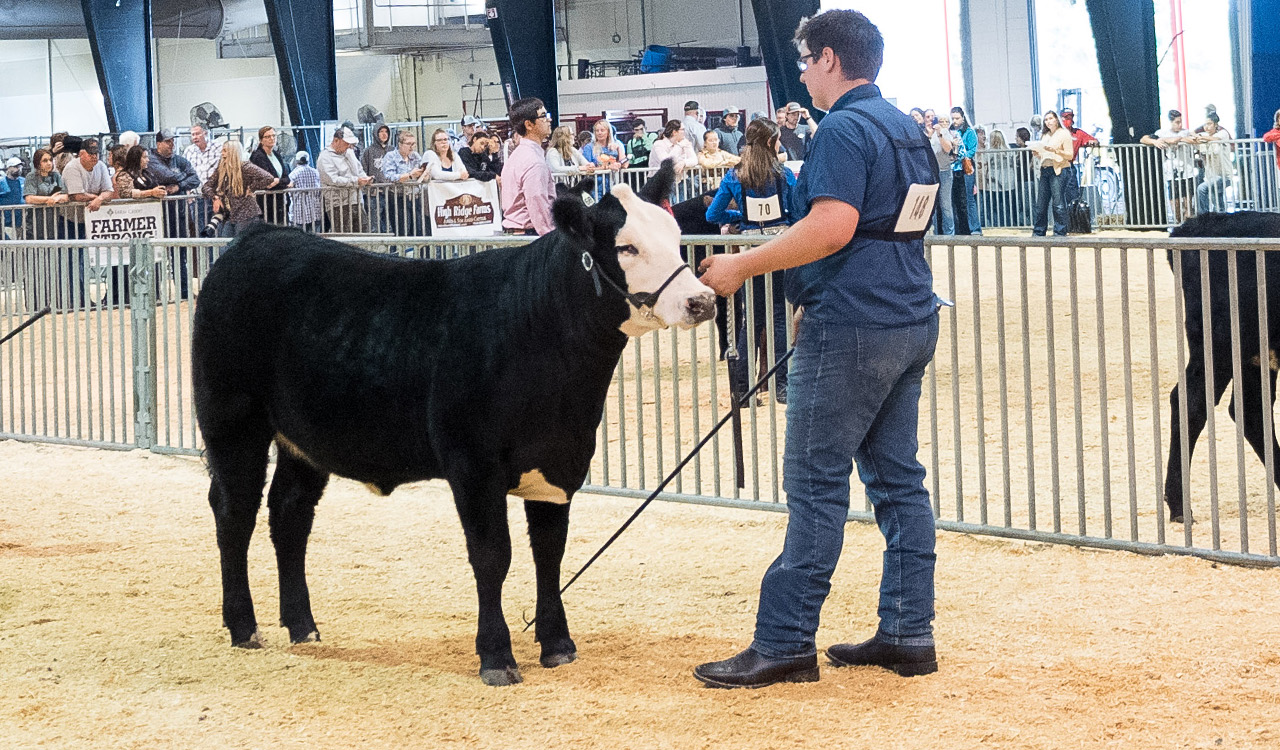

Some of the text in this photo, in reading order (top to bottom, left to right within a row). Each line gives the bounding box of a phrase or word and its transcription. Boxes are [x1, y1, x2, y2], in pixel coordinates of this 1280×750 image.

[437, 205, 452, 219] High
[453, 205, 473, 218] Ridge
[758, 203, 771, 217] 70
[91, 216, 157, 234] FARMER
